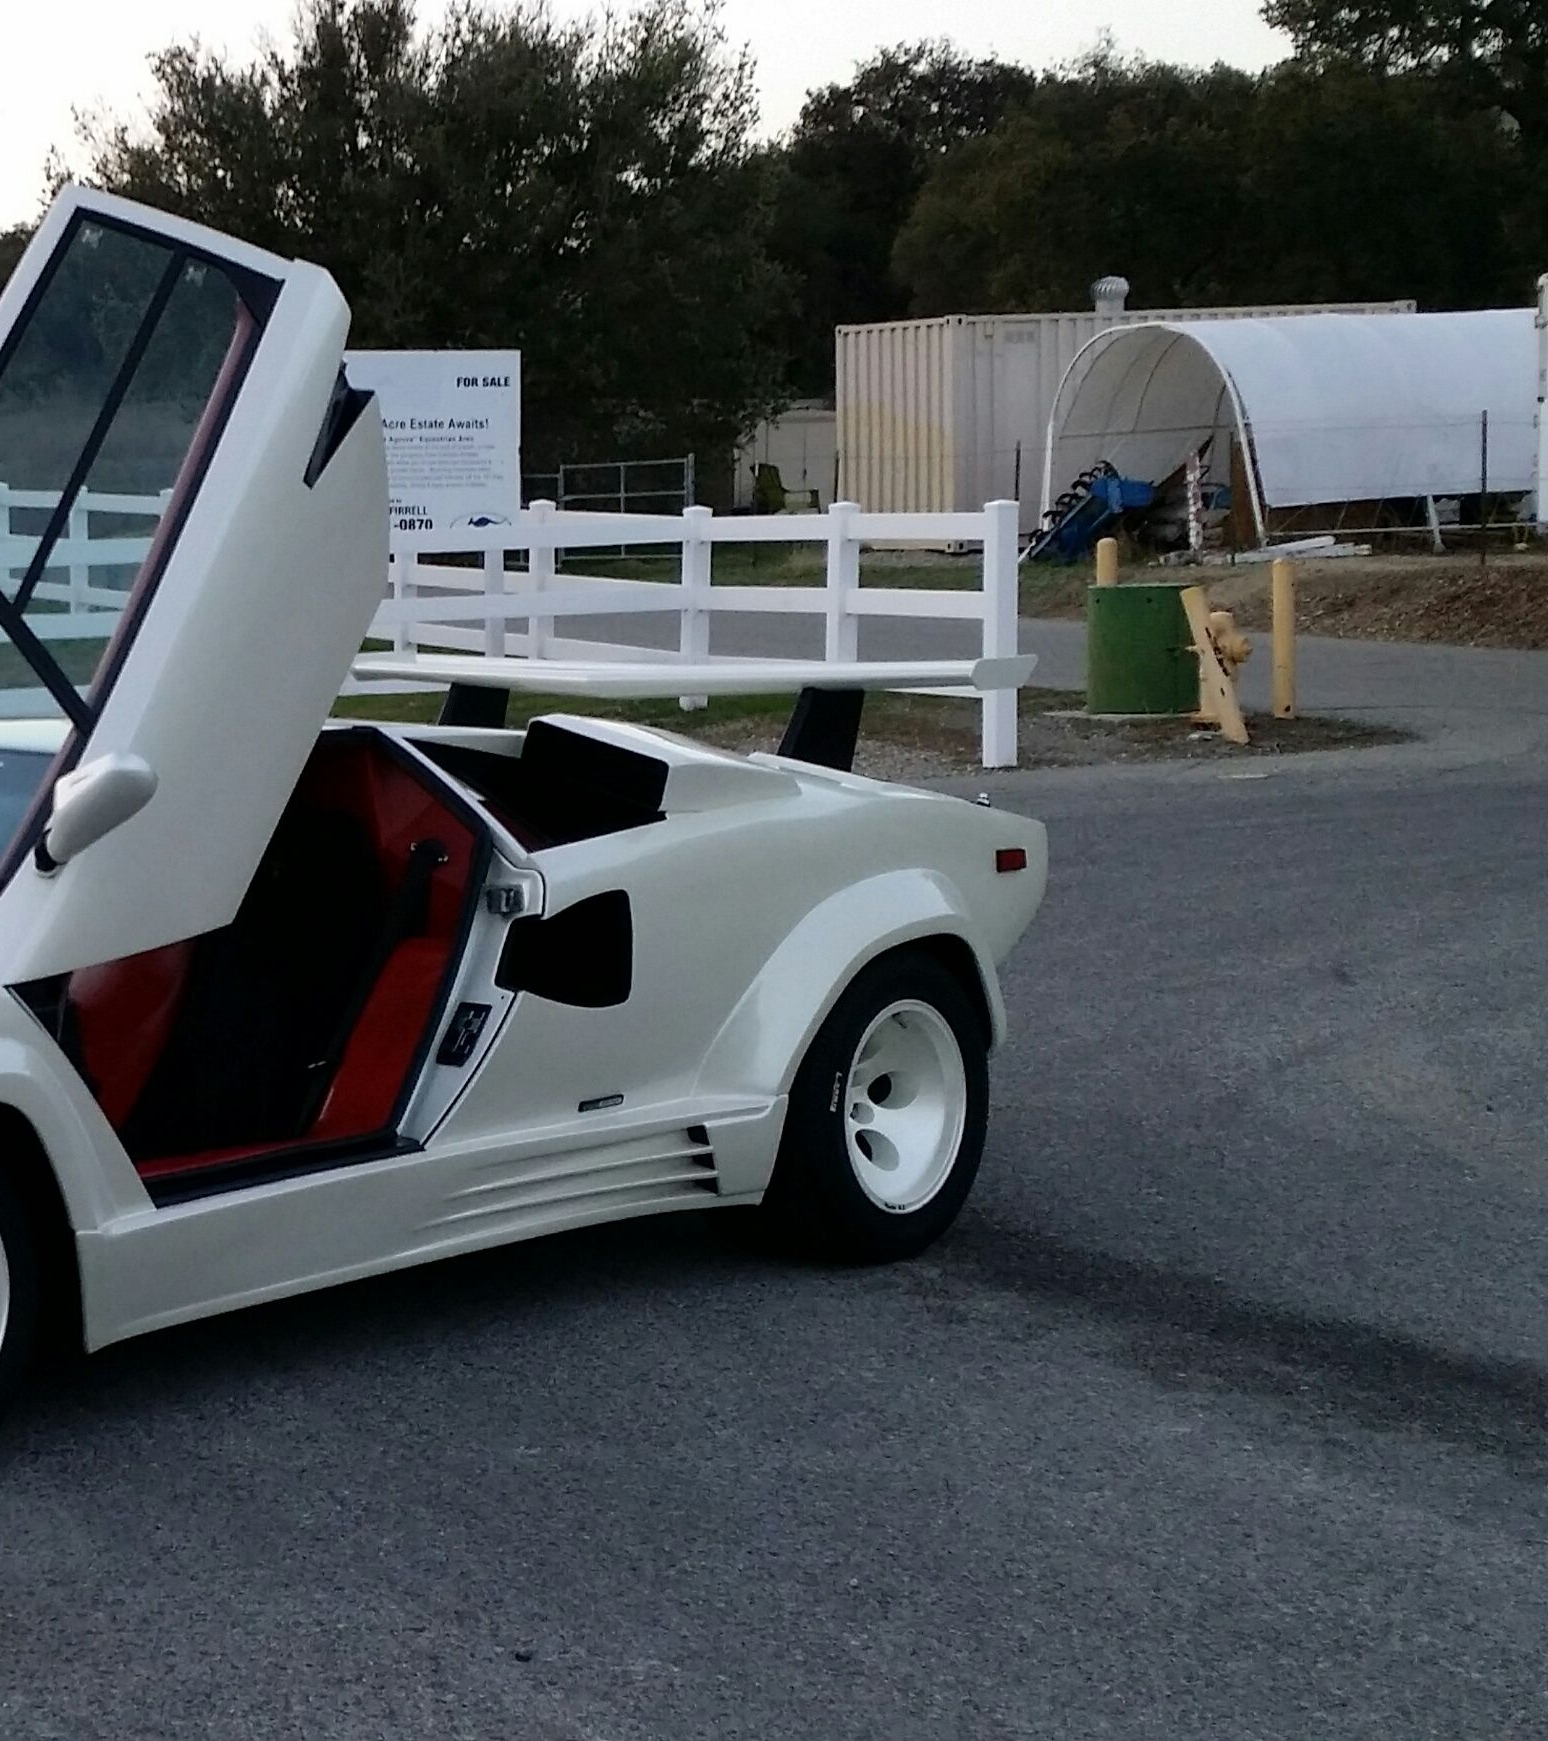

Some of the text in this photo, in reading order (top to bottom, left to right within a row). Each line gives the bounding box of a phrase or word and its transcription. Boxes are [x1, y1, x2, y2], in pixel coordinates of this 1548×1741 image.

[456, 376, 510, 388] FOR SALE
[410, 418, 445, 430] Estate
[448, 418, 489, 430] Awaits!
